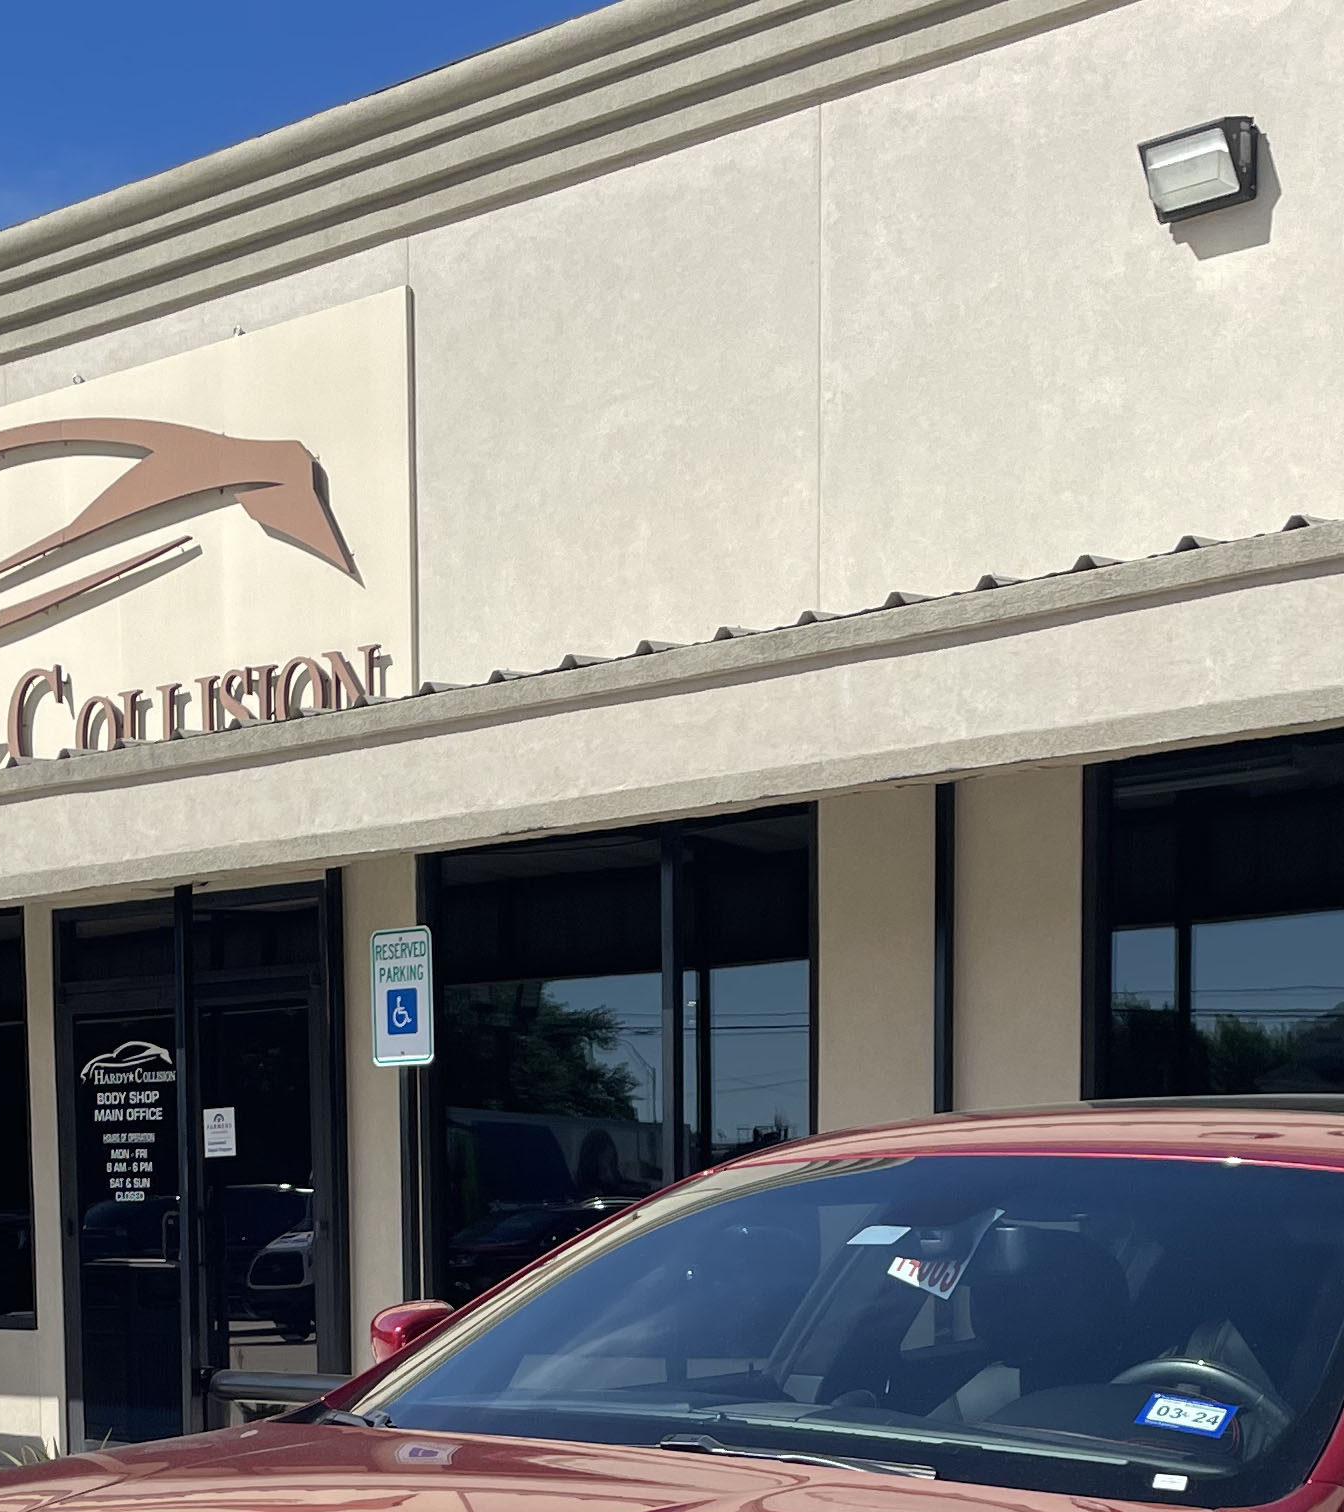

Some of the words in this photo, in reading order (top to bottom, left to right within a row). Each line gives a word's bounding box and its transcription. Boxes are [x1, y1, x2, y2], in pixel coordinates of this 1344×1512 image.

[7, 643, 382, 759] COLLISION
[376, 940, 427, 961] RESERVED
[379, 964, 424, 983] PARKING
[94, 1069, 129, 1085] HARDY
[134, 1067, 177, 1083] COLLISION
[96, 1092, 126, 1105] BODY
[129, 1090, 160, 1104] SHOP
[94, 1108, 123, 1122] MAIN
[126, 1107, 163, 1121] OFFICE
[110, 1148, 130, 1159] MON
[135, 1148, 148, 1159] FRI
[113, 1162, 127, 1172] AM
[139, 1161, 153, 1172] PM
[109, 1177, 124, 1188] SAT
[125, 1177, 132, 1188] &
[133, 1177, 151, 1188] SUN
[115, 1191, 145, 1202] CLOSED
